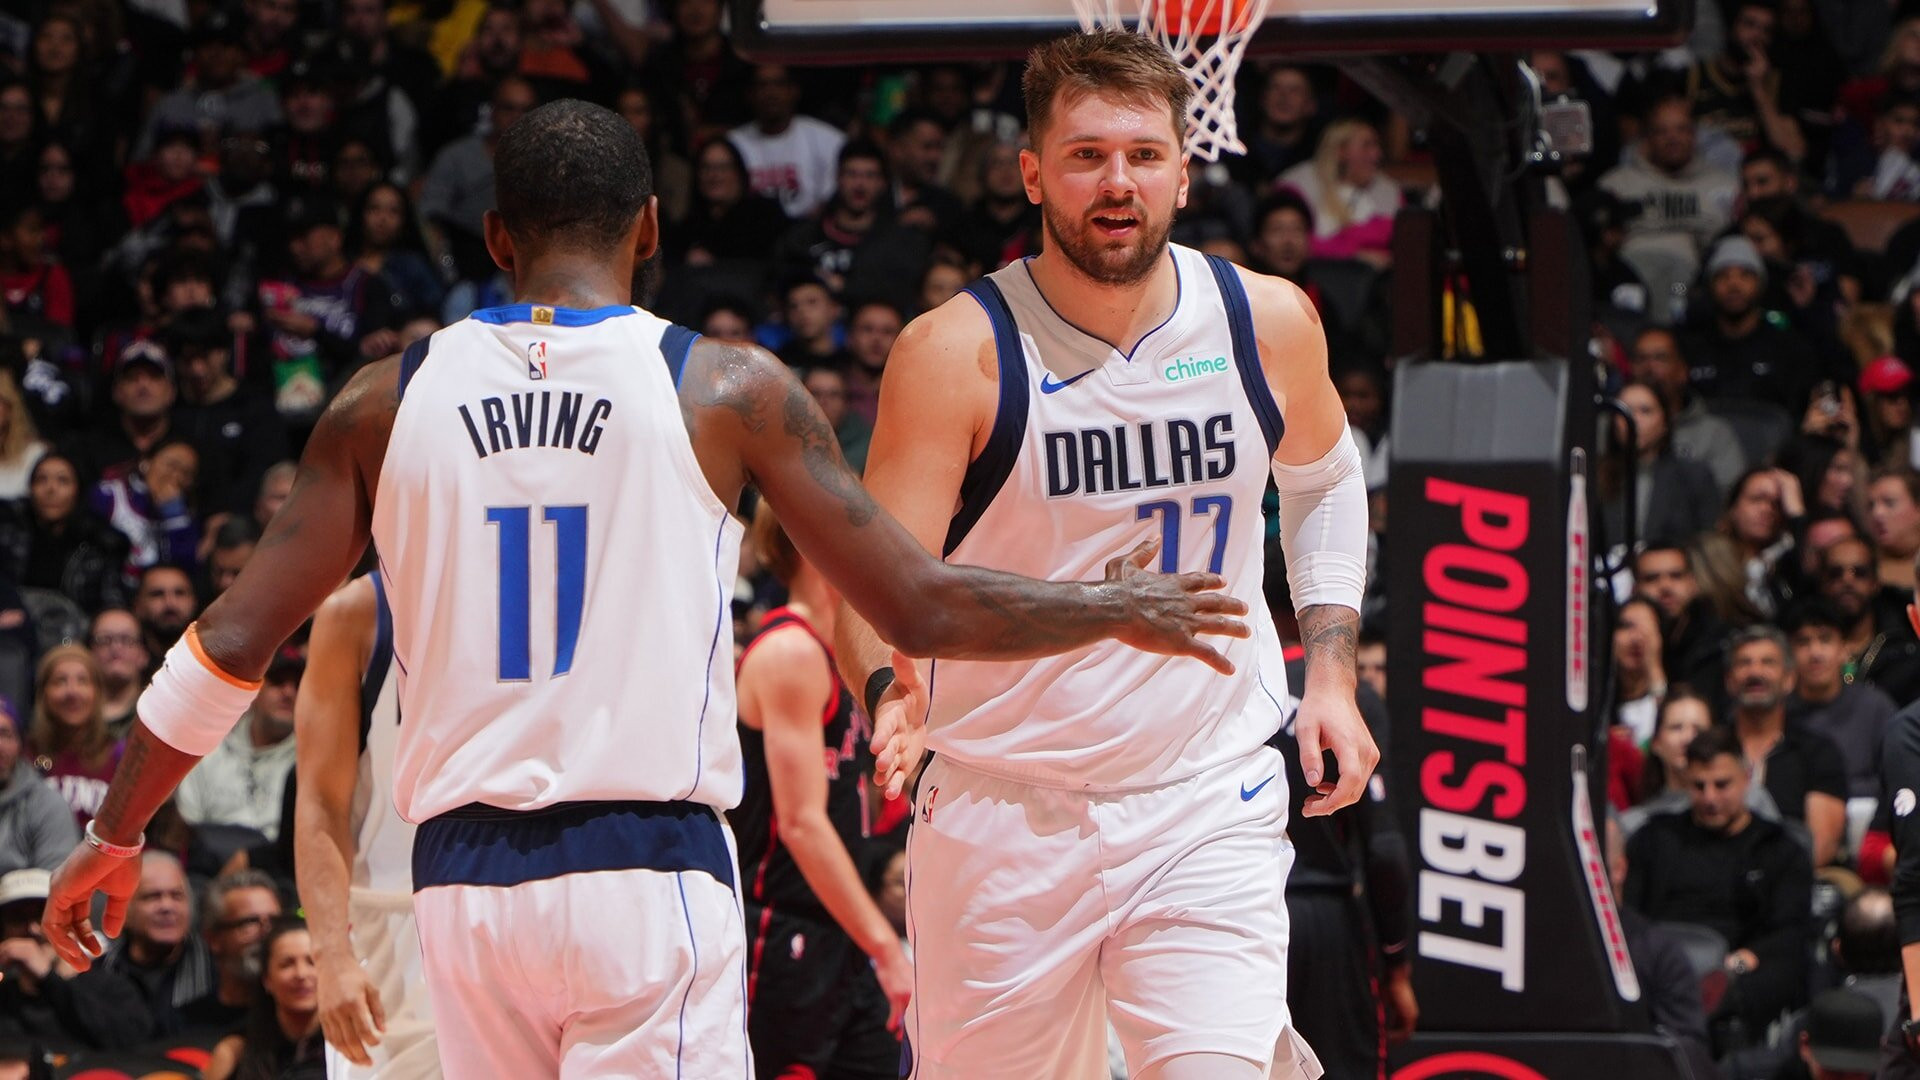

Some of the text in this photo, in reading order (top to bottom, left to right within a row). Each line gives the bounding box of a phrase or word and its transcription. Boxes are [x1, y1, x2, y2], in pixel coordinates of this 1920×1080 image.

[1164, 356, 1229, 381] chime
[457, 390, 613, 459] IRVING
[1042, 412, 1238, 500] DALLAS
[1135, 493, 1234, 575] 77
[484, 503, 590, 684] 11
[1418, 476, 1530, 993] POINTSBET
